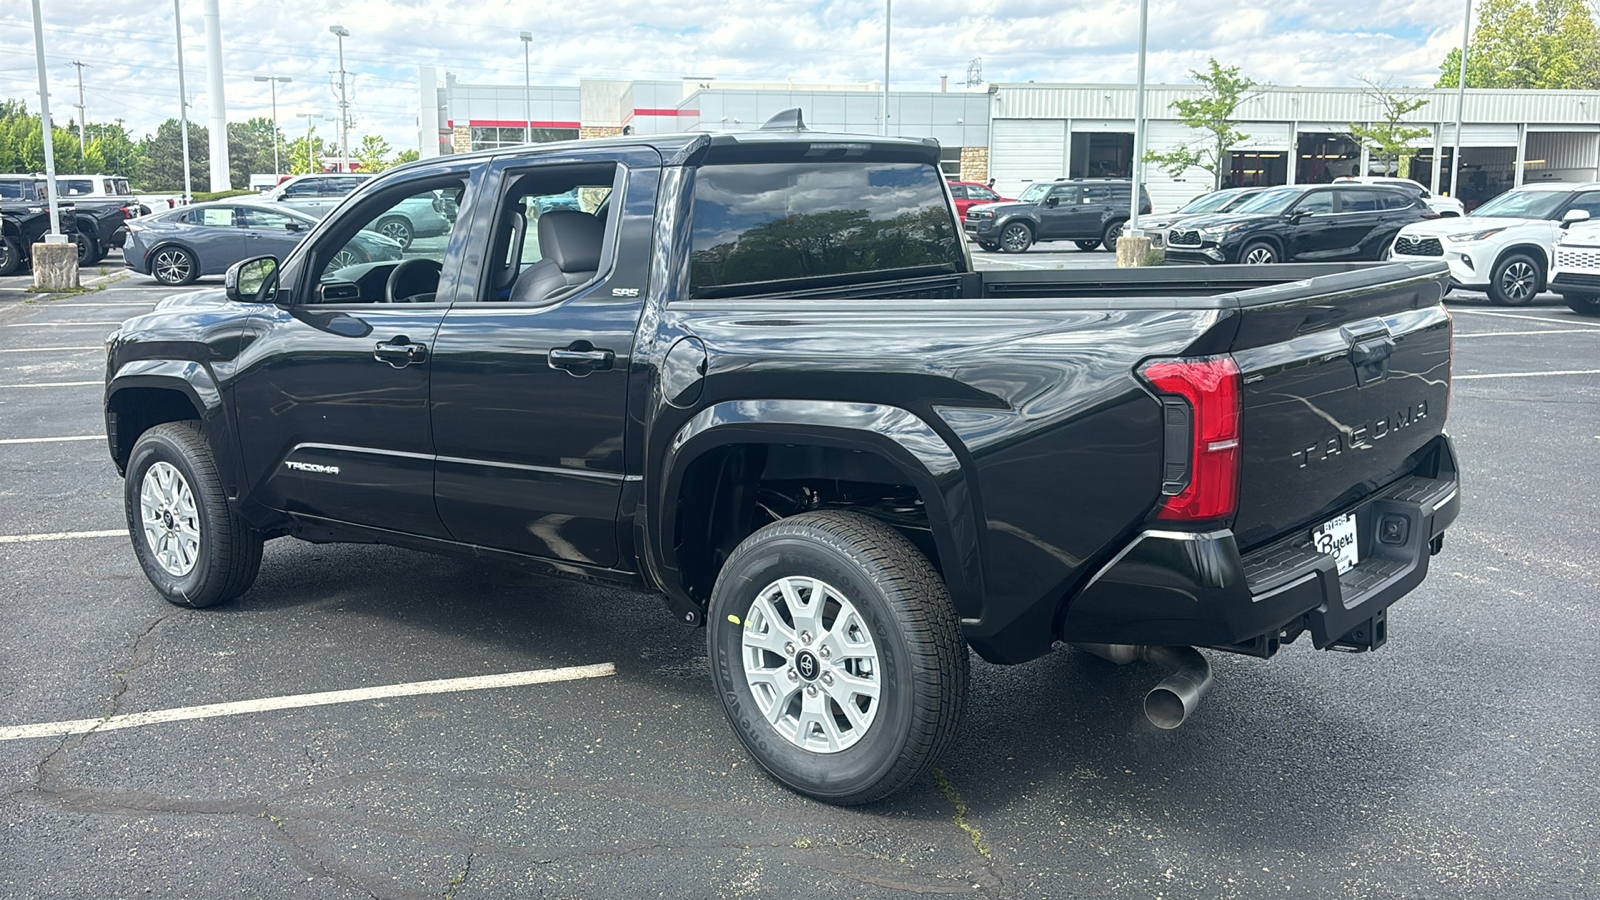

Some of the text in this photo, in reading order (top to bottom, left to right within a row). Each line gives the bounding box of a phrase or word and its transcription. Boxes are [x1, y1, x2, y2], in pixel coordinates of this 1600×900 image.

[611, 287, 640, 298] SR5
[1292, 400, 1428, 468] TACOMA
[285, 461, 340, 475] TACOMA
[1317, 533, 1354, 560] Byers
